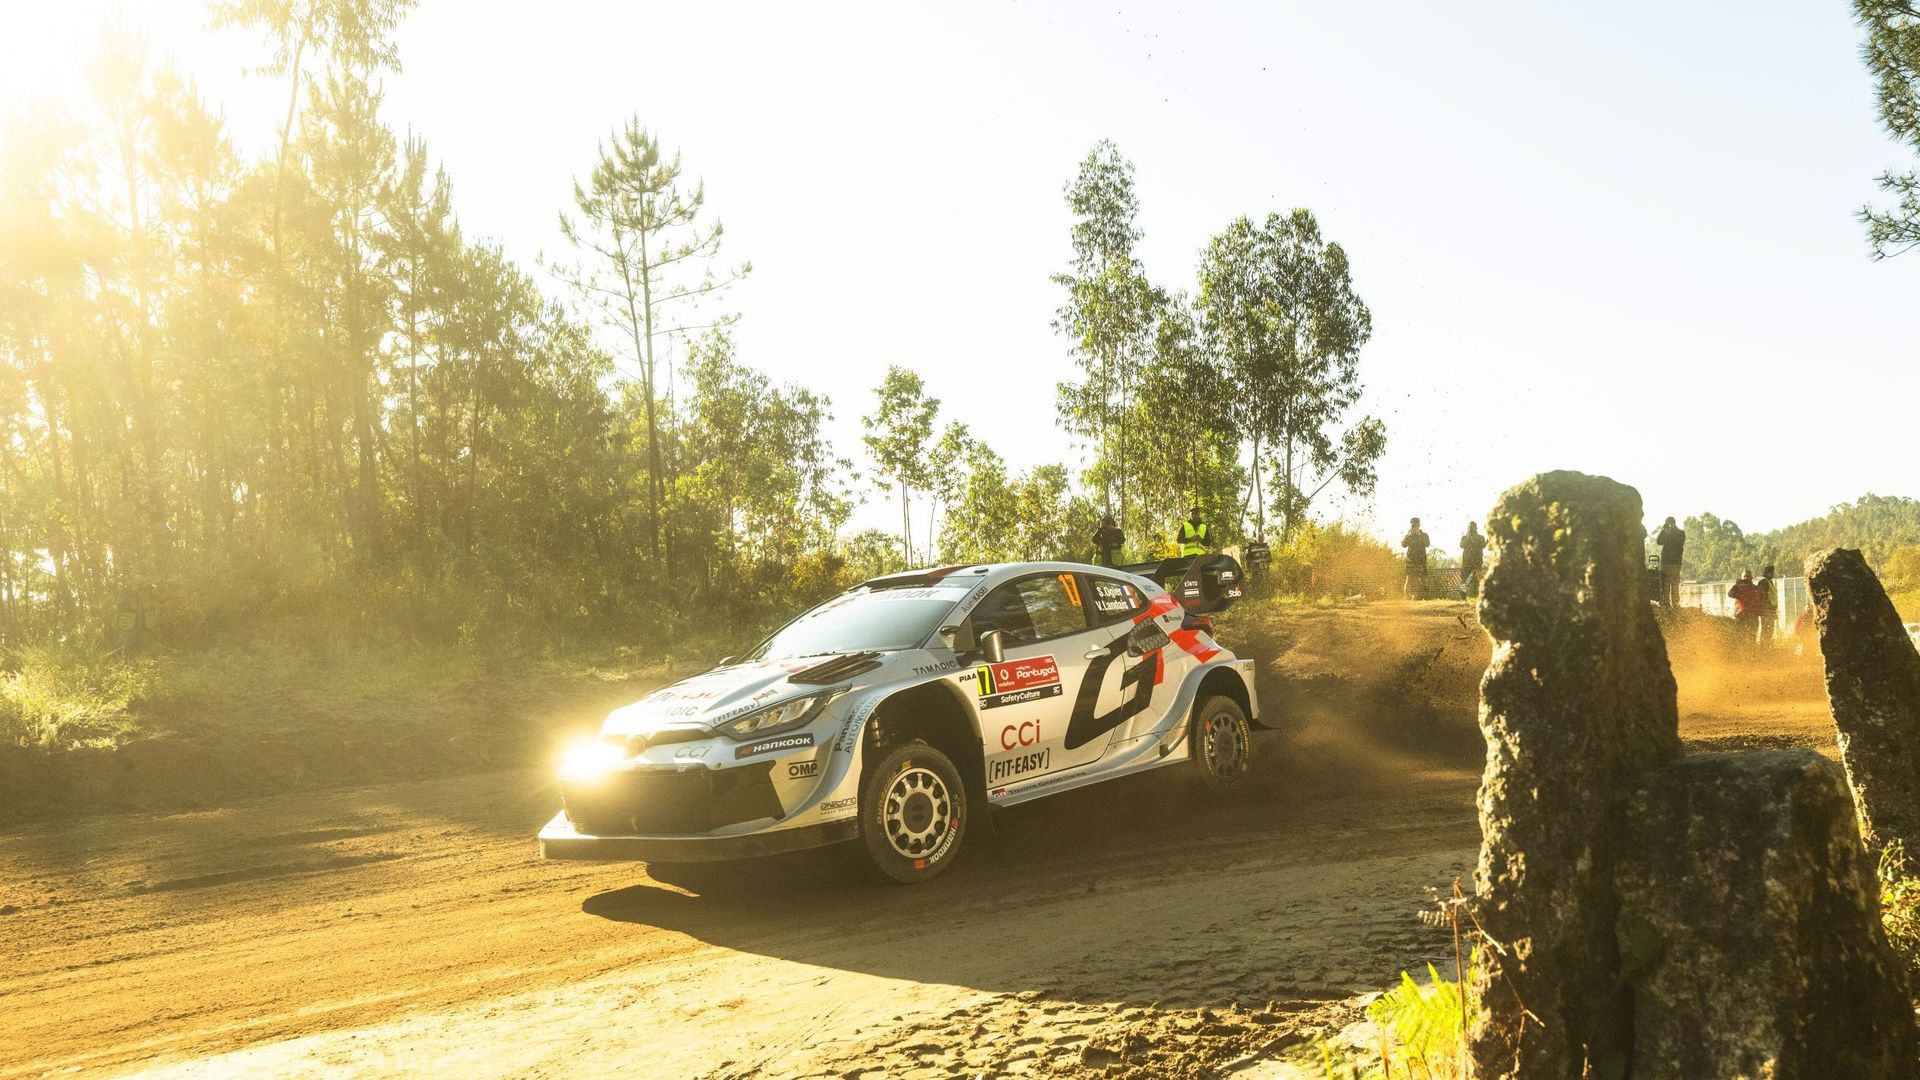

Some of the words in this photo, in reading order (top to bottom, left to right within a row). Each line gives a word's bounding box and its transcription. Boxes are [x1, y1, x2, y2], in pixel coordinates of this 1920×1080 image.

[1059, 574, 1082, 607] 17
[1096, 585, 1123, 599] S.Ogier
[1094, 599, 1129, 611] V.Landais
[912, 659, 957, 676] TAMADIC
[1016, 666, 1057, 680] Portugal
[959, 672, 977, 683] PIAA
[1000, 690, 1040, 704] SafetyCulture
[788, 763, 818, 777] OMP
